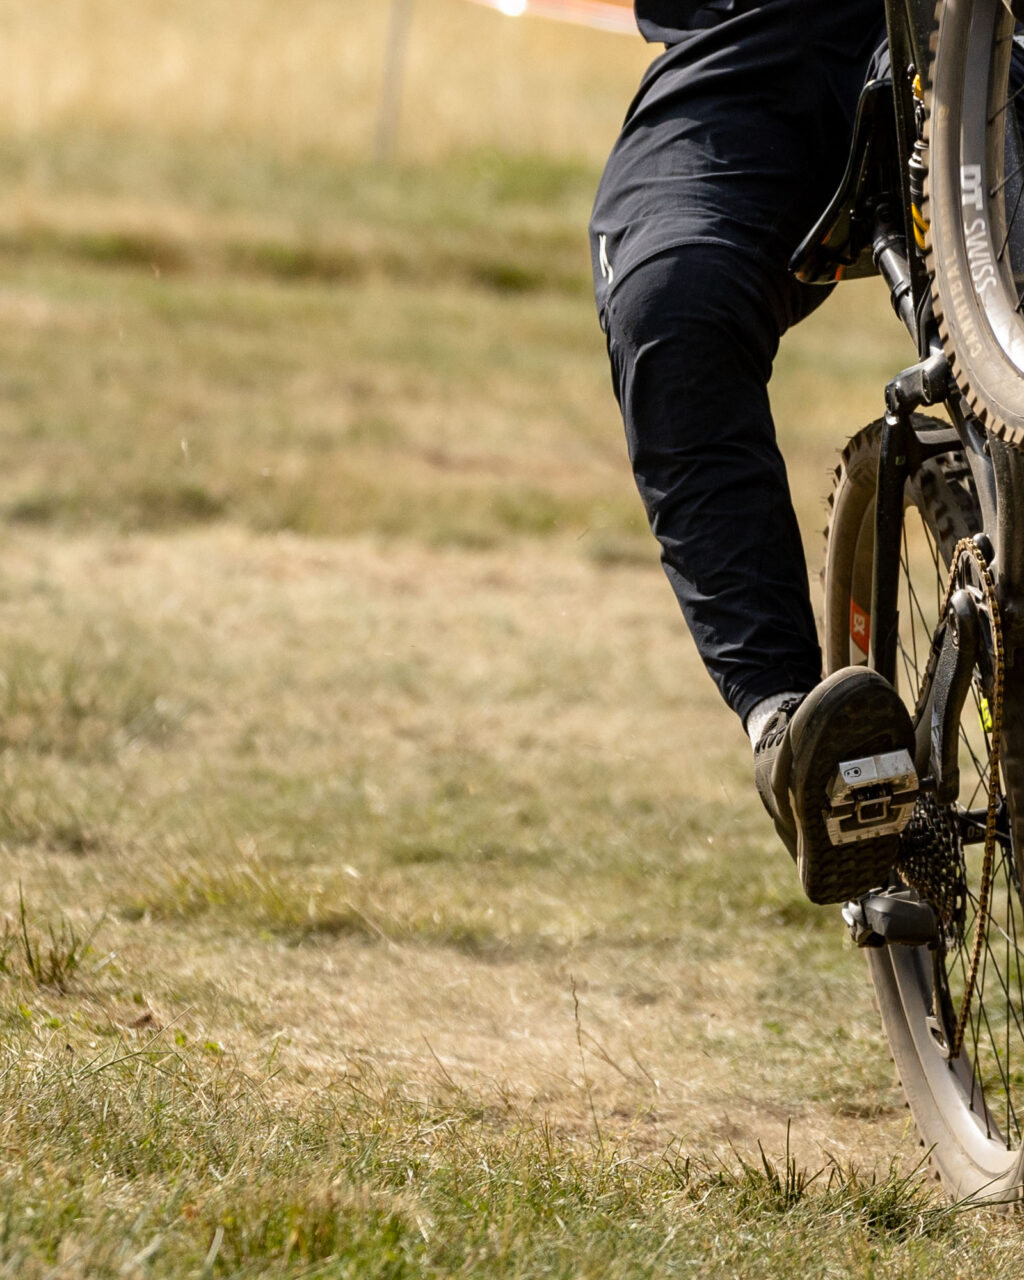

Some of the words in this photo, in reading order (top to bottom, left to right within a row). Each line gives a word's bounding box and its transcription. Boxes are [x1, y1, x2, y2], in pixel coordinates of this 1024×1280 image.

[960, 164, 984, 211] DT
[963, 218, 997, 293] SWISS
[944, 247, 983, 359] CANNIBAL
